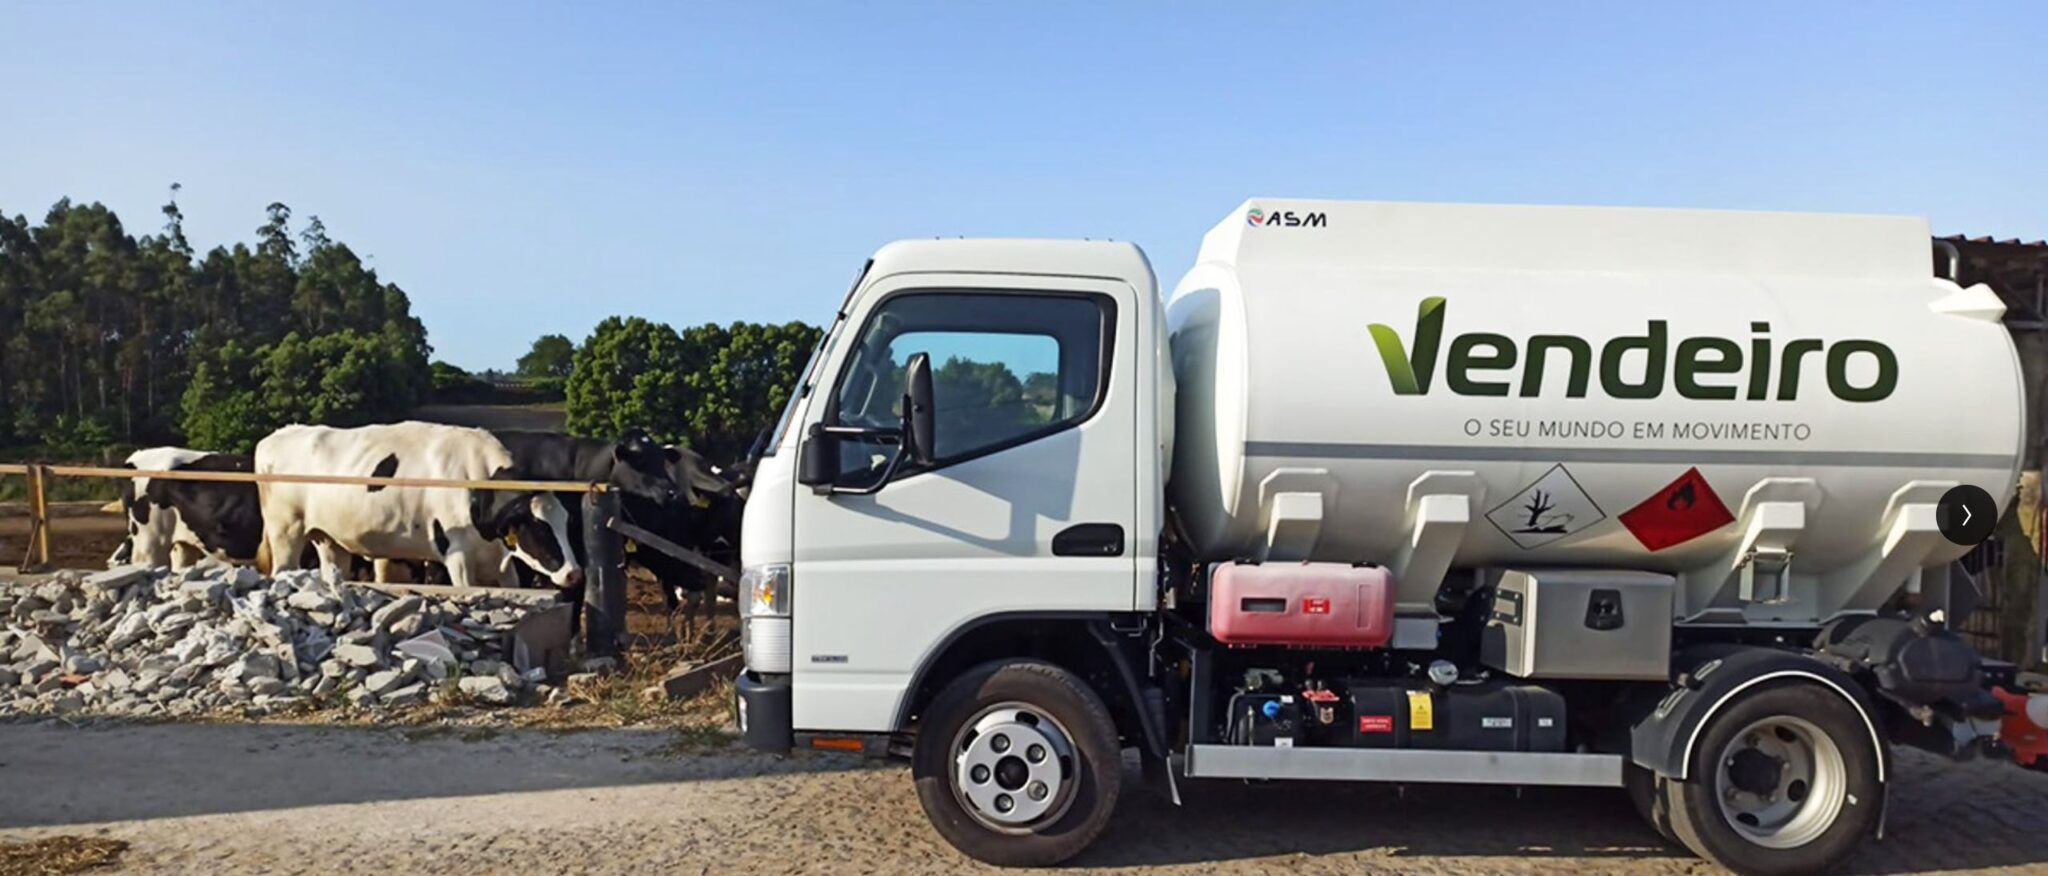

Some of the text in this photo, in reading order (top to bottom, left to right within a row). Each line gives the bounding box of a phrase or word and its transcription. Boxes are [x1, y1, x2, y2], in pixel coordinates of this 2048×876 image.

[1266, 211, 1327, 227] ASM
[1367, 296, 1898, 402] Vendeiro
[1464, 418, 1812, 441] O SEU MUNDO EM MOVIMENTO
